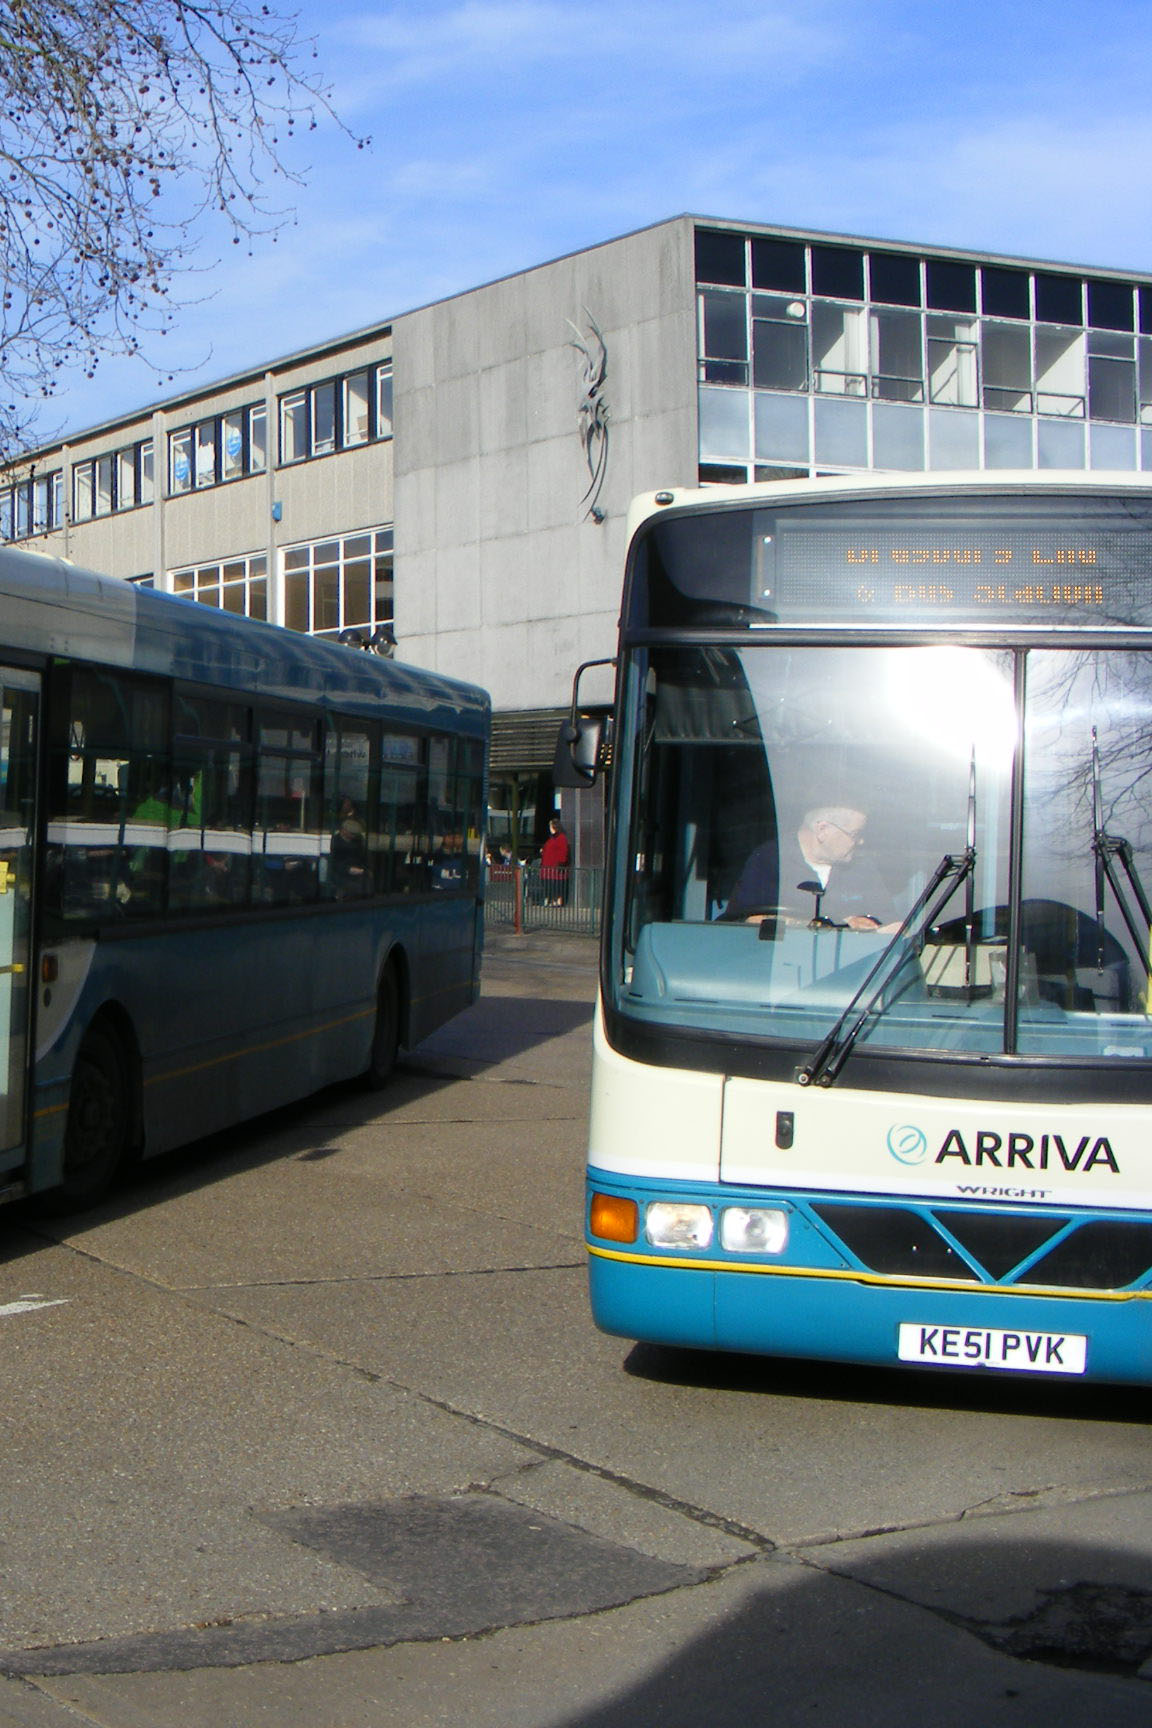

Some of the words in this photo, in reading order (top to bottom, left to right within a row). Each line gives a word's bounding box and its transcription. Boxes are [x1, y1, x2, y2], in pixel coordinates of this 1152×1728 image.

[934, 1129, 1120, 1174] ARRIVA
[956, 1185, 1053, 1199] WRIGHT
[919, 1327, 991, 1360] KE51
[1001, 1333, 1065, 1364] PVK
